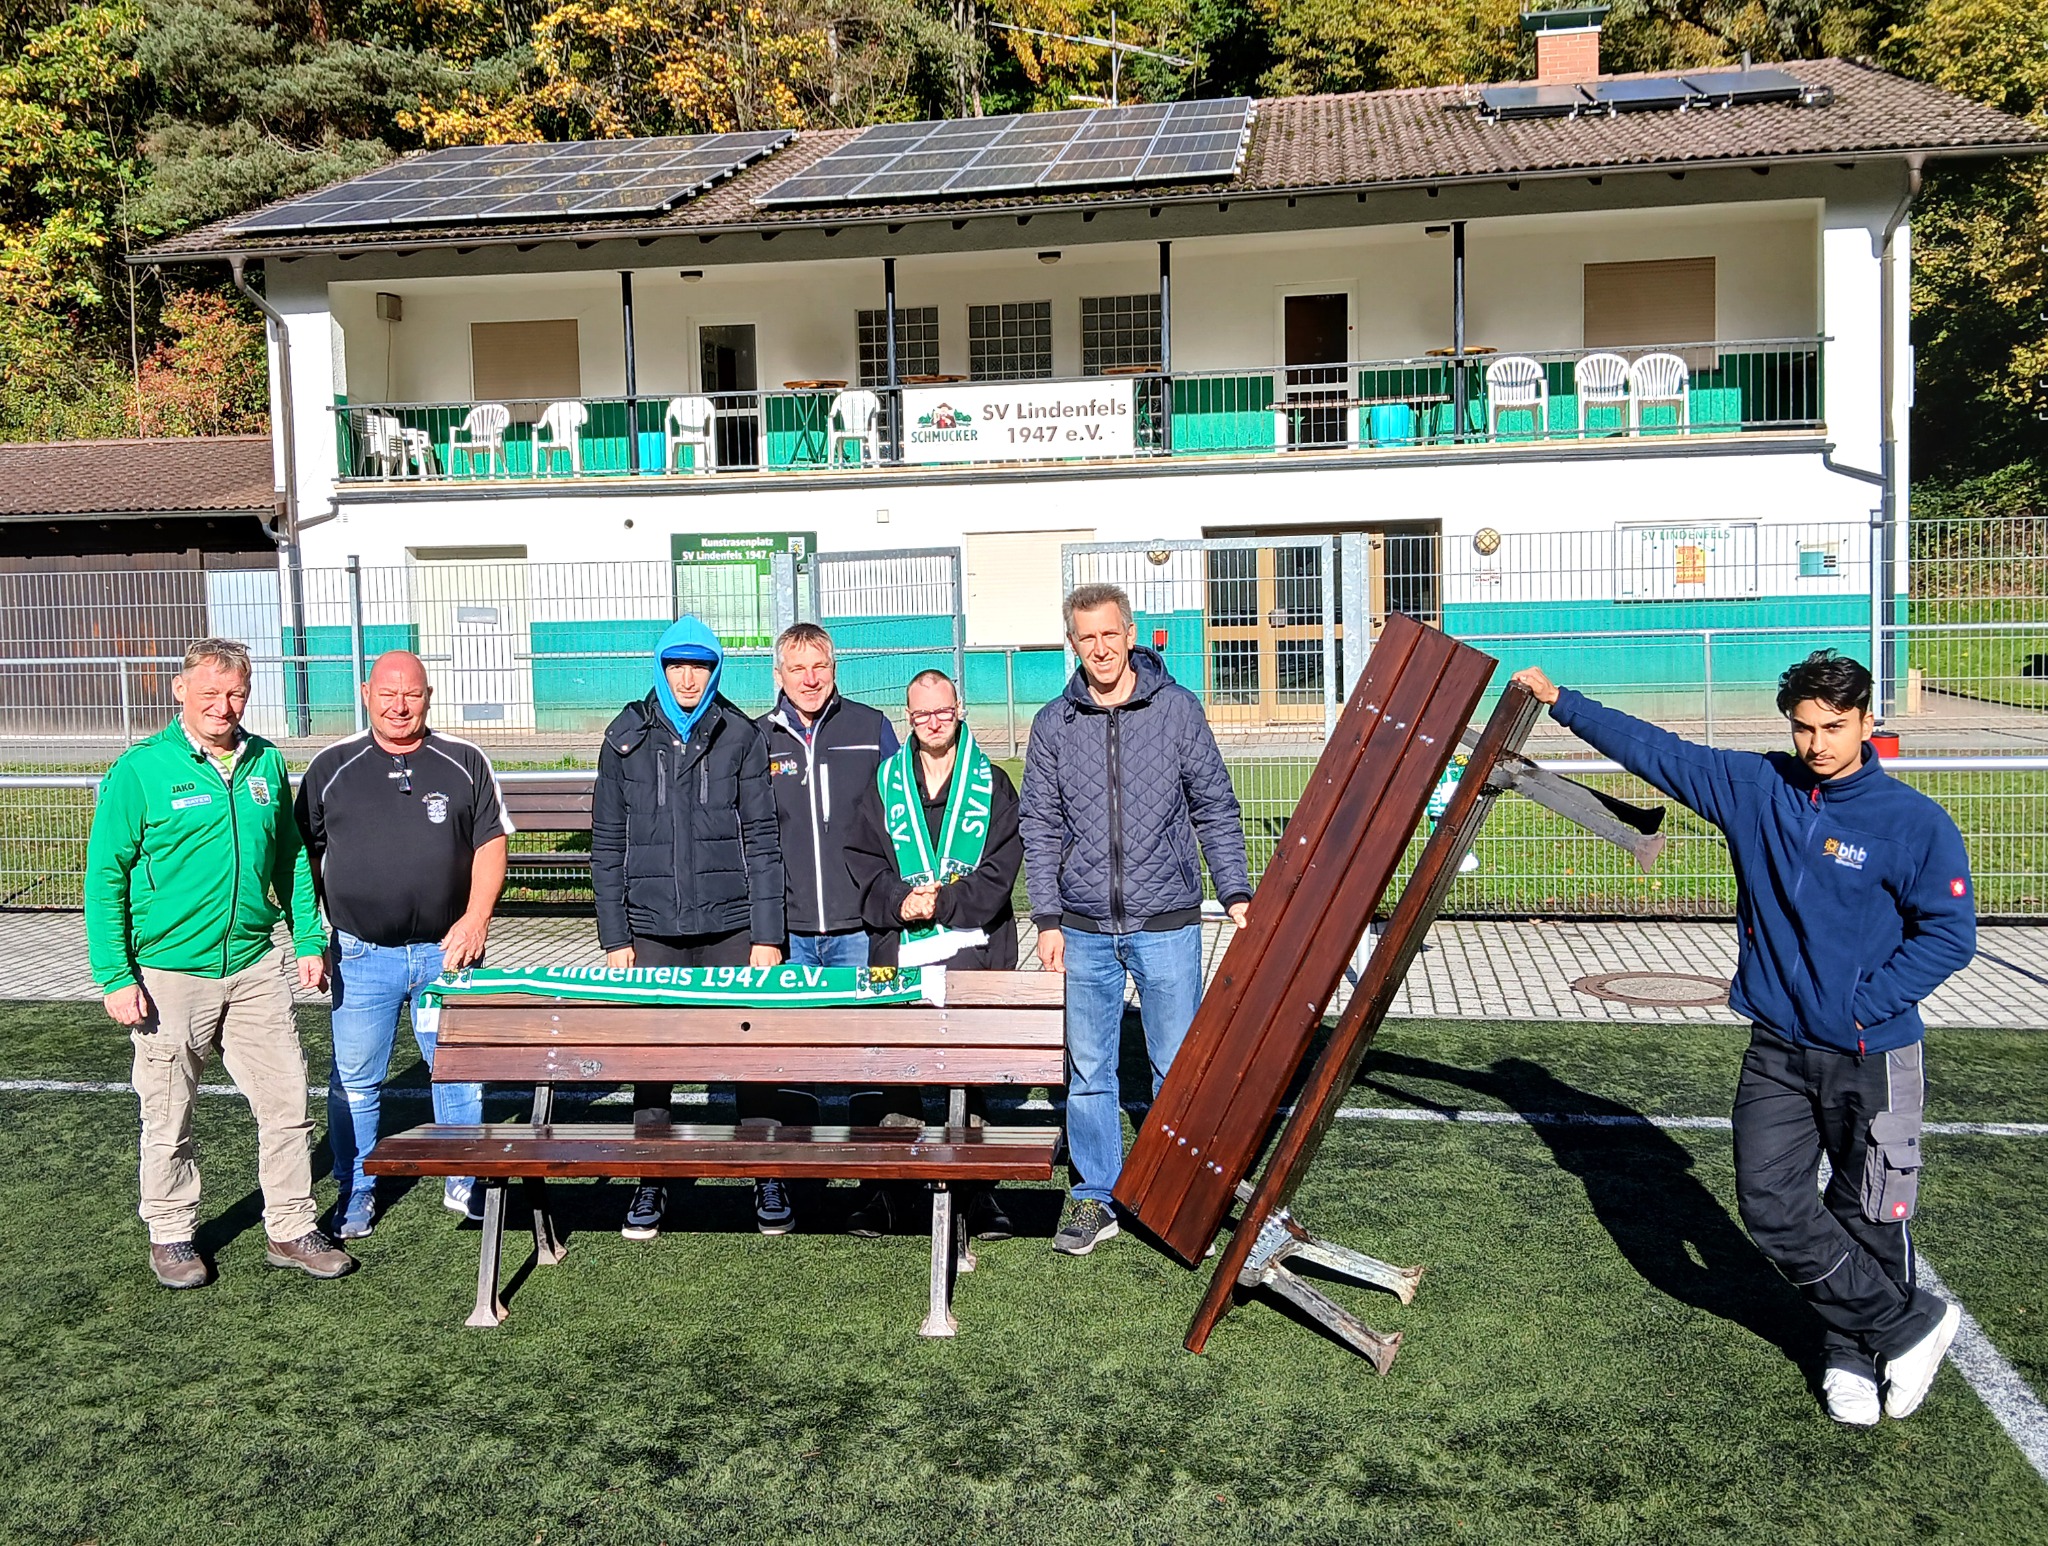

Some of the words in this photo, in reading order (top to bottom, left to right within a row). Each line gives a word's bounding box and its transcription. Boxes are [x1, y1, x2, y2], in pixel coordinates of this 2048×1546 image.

[983, 403, 1010, 421] SV
[1017, 399, 1127, 420] Lindenfels
[911, 429, 978, 443] SCHMUCKER
[1008, 426, 1058, 443] 1947
[1066, 424, 1103, 442] e.V.
[701, 537, 774, 549] Kunstrasenplatz
[1641, 531, 1655, 541] SV
[1660, 529, 1730, 540] LINDENFELS
[682, 551, 694, 560] SV
[696, 550, 742, 560] Lindenfels
[746, 550, 766, 560] 1947
[780, 759, 798, 770] bhb
[172, 783, 195, 793] JAKO
[961, 797, 989, 838] SV
[890, 803, 911, 851] e.V.
[1838, 842, 1867, 861] bhb
[701, 966, 770, 988] 1947
[779, 965, 828, 988] e.V.
